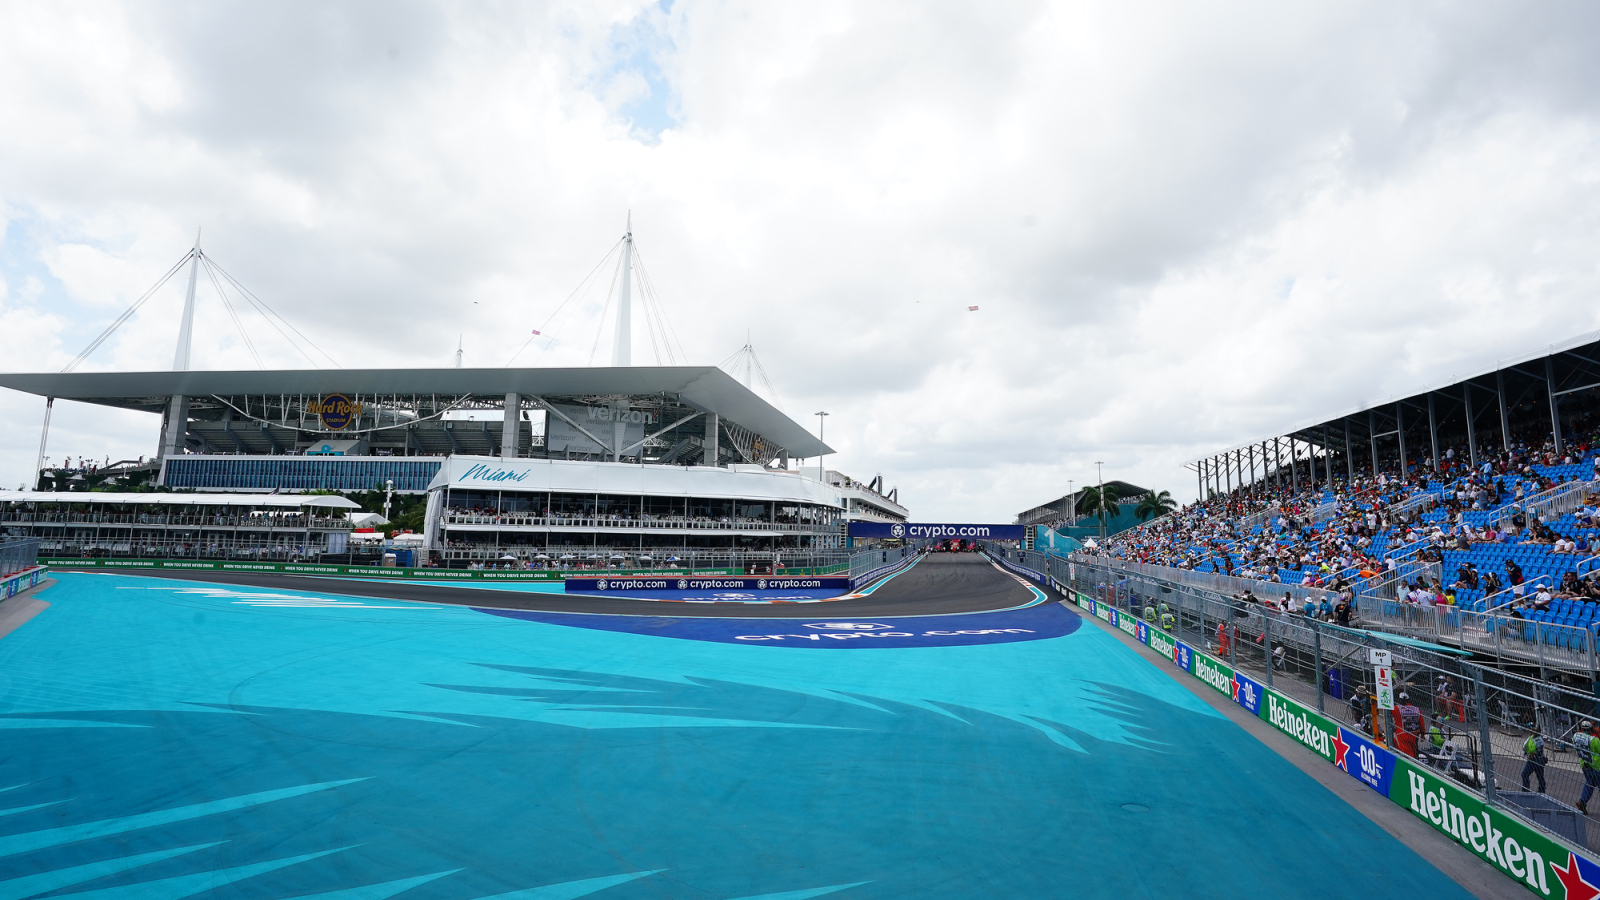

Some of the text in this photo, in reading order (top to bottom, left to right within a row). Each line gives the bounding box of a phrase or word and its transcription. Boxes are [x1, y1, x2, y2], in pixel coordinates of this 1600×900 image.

[308, 401, 363, 416] Hard Rock
[587, 405, 653, 424] verizon
[458, 463, 531, 482] Miami
[909, 524, 990, 538] crypto.com
[1044, 529, 1055, 548] 1
[610, 580, 667, 589] crypto.com
[690, 580, 744, 589] crypto.com
[769, 579, 821, 589] crypto.com
[735, 628, 1036, 641] crypto.com
[1150, 629, 1173, 659] Heineken
[1195, 654, 1231, 695] Heineken
[1267, 694, 1331, 757] Heineken
[1407, 769, 1551, 895] Heineken
